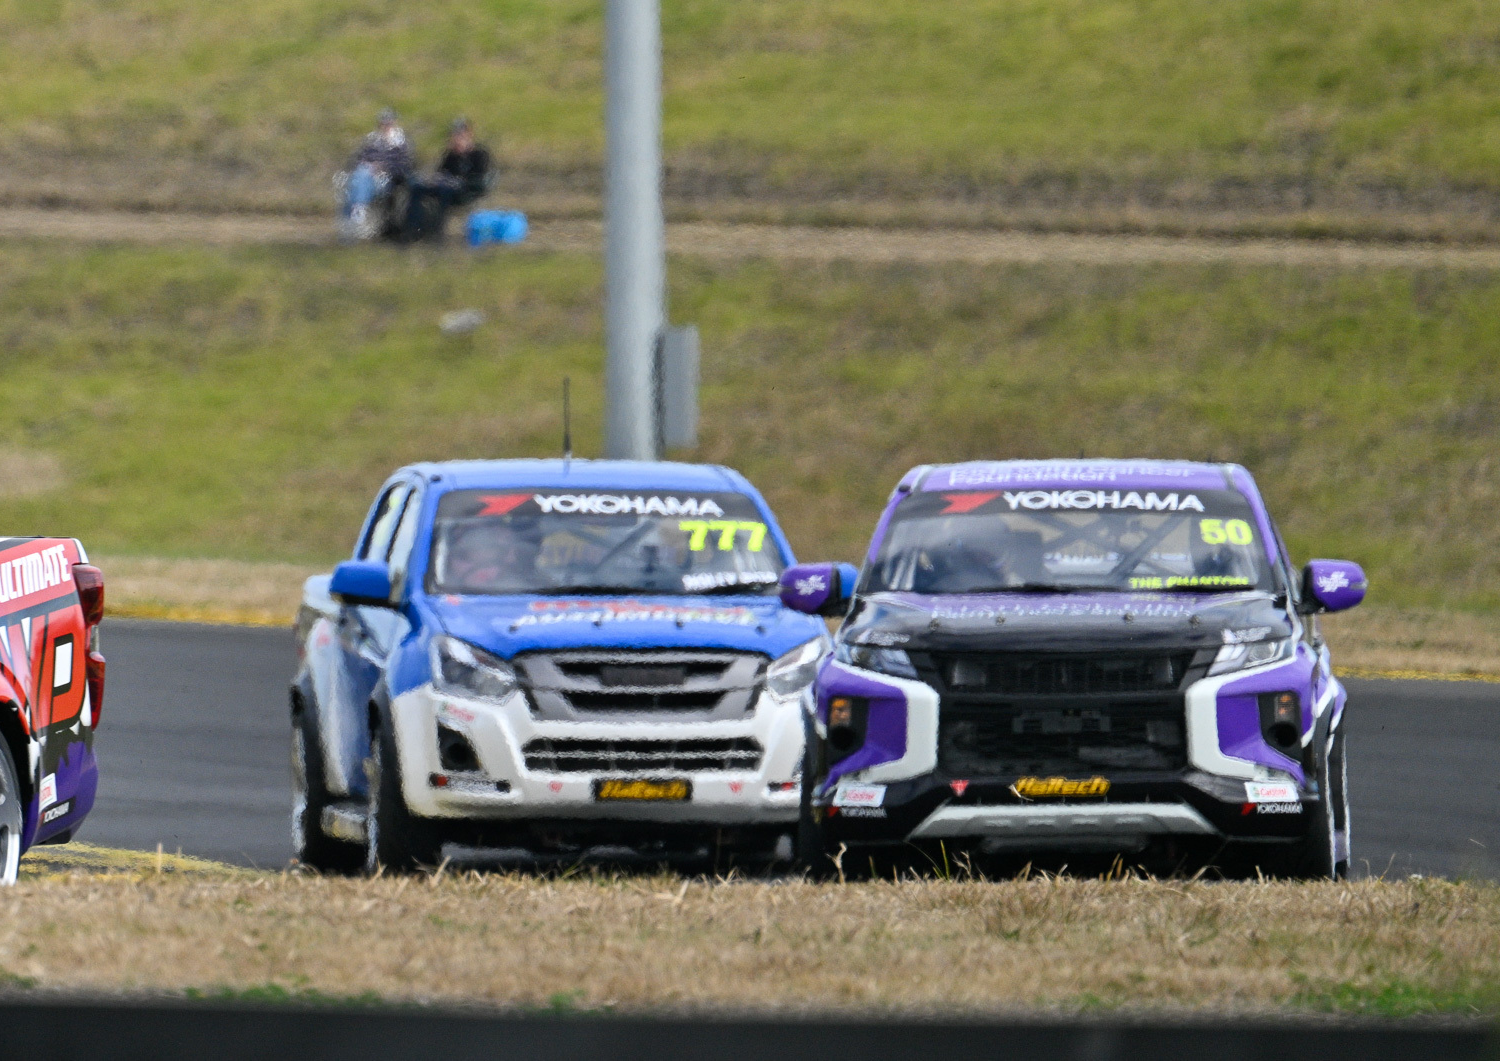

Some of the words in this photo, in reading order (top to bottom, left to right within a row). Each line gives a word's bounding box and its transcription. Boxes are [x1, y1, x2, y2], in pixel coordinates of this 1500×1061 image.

[534, 493, 725, 517] YOKOHAMA
[1003, 489, 1205, 512] YOKOHAMA
[679, 520, 767, 551] 777
[1199, 518, 1254, 545] 50
[1129, 576, 1163, 590] THE
[1012, 776, 1111, 797] Haltech
